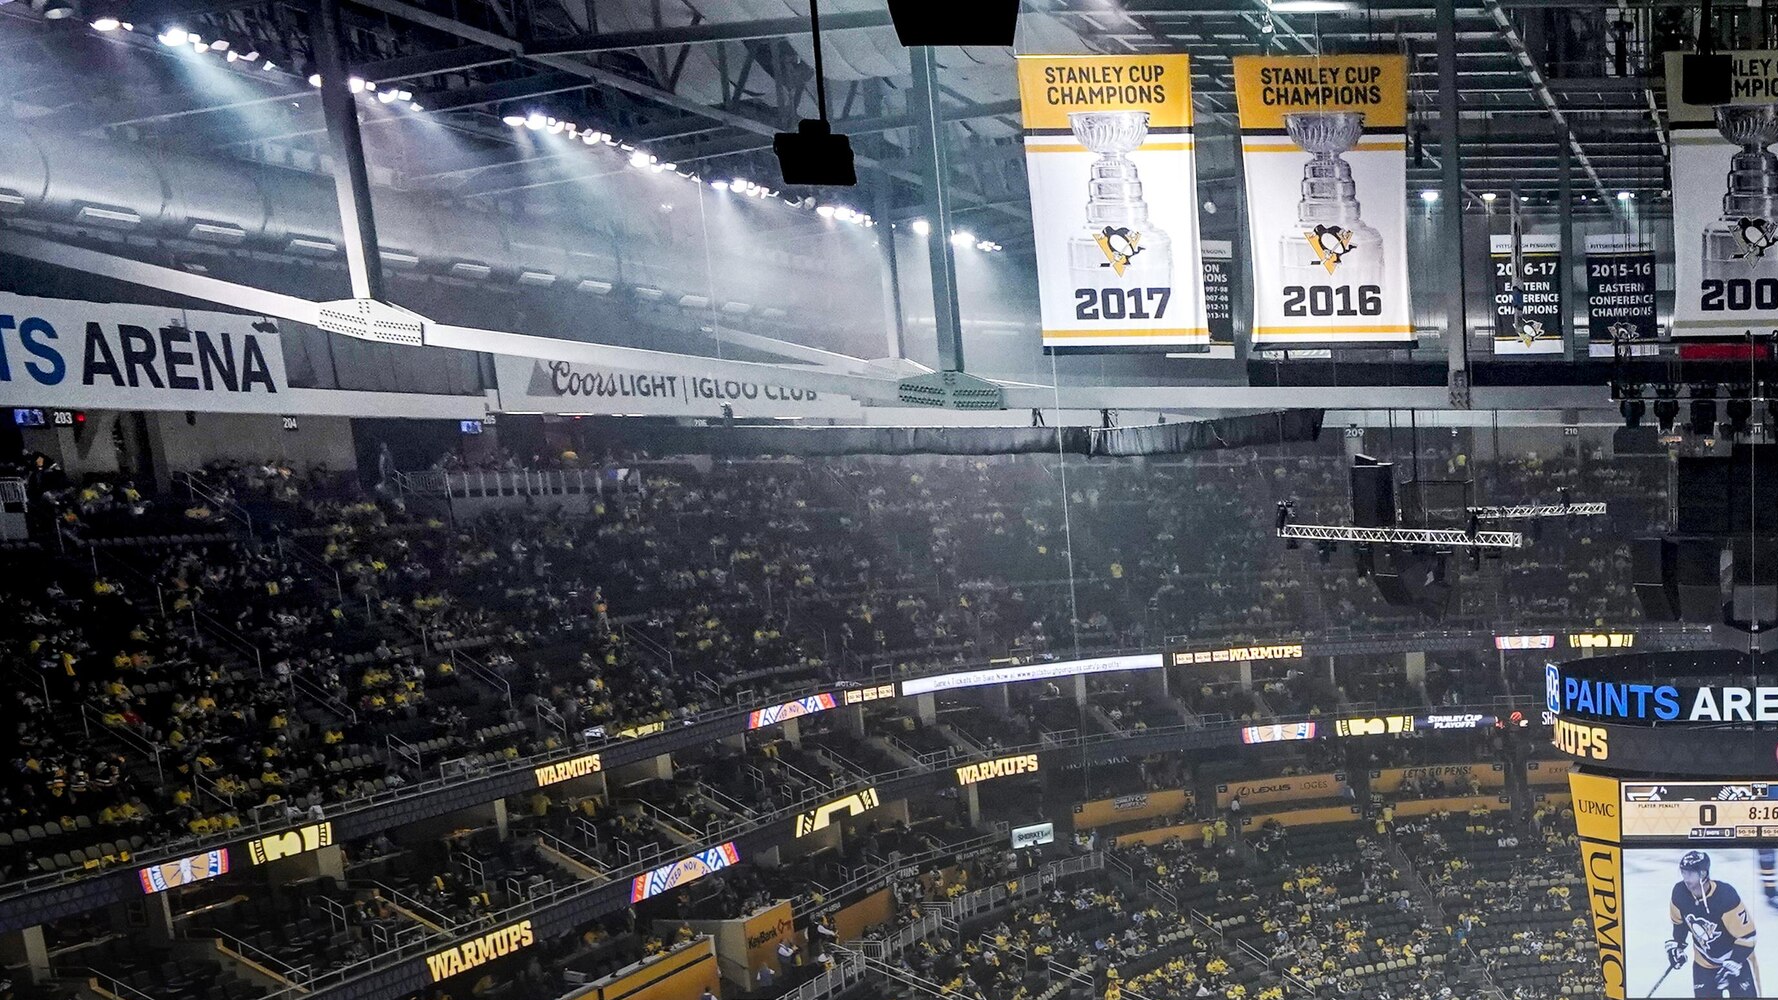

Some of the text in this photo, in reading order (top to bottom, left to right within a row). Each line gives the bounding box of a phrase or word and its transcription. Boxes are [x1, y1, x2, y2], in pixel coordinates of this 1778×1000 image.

[1045, 65, 1164, 83] STANLEY CUP
[1261, 66, 1381, 85] STANLEY CUP
[1047, 85, 1165, 105] CHAMPIONS
[1262, 86, 1381, 105] CHAMPIONS
[1496, 262, 1557, 276] 206-17
[1592, 263, 1651, 277] 2015-16
[1599, 283, 1644, 293] EASTERN
[1075, 287, 1171, 320] 2017
[1284, 285, 1382, 317] 2016
[1589, 294, 1653, 305] CONFERENCE
[1592, 307, 1653, 317] CHAMPIONS
[83, 320, 278, 394] ARENA
[620, 372, 678, 398] LIGHT
[54, 411, 73, 425] 203
[283, 417, 298, 429] 204
[1229, 645, 1302, 662] WARMUPS
[1565, 676, 1680, 721] PAINTS
[1427, 714, 1483, 723] STANLEY CUP
[1434, 721, 1476, 729] PLAYOFFS
[534, 753, 601, 787] WARMUPS
[956, 754, 1038, 786] WARMUPS
[1428, 767, 1442, 777] GO
[1443, 766, 1472, 777] PENS!
[1250, 783, 1291, 795] LEXUS
[1579, 799, 1615, 818] UPMC
[1042, 874, 1054, 885] 104
[1590, 850, 1625, 991] UPMC
[747, 923, 778, 950] KeyBank
[426, 920, 534, 983] WARMUPS
